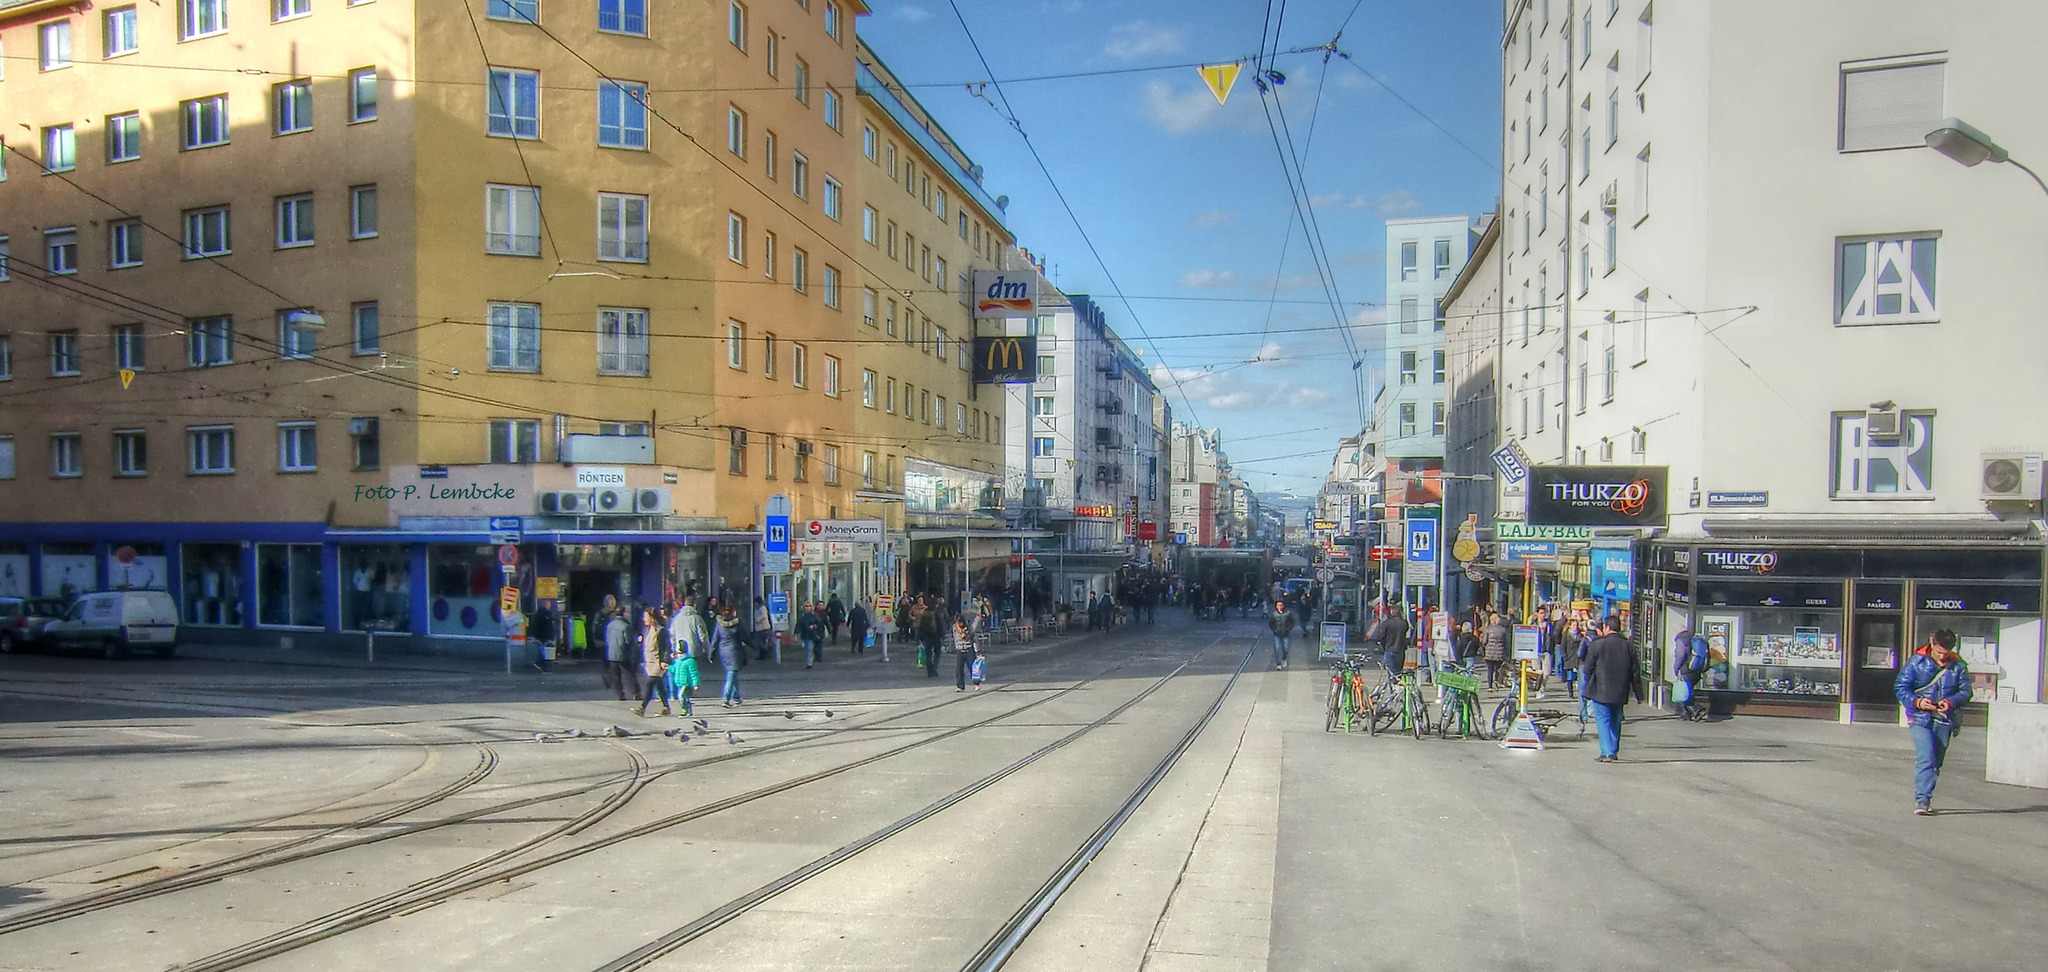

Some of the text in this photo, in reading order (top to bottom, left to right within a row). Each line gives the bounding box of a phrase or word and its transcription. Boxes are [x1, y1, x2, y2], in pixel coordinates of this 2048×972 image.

[987, 276, 1027, 299] dm
[1500, 449, 1525, 477] FOTO
[579, 471, 623, 483] RÖNTGEN
[1545, 483, 1643, 501] THURZO
[1499, 524, 1591, 538] LADY-BAG
[1703, 552, 1774, 566] THURZO
[1926, 599, 1963, 609] XENOX
